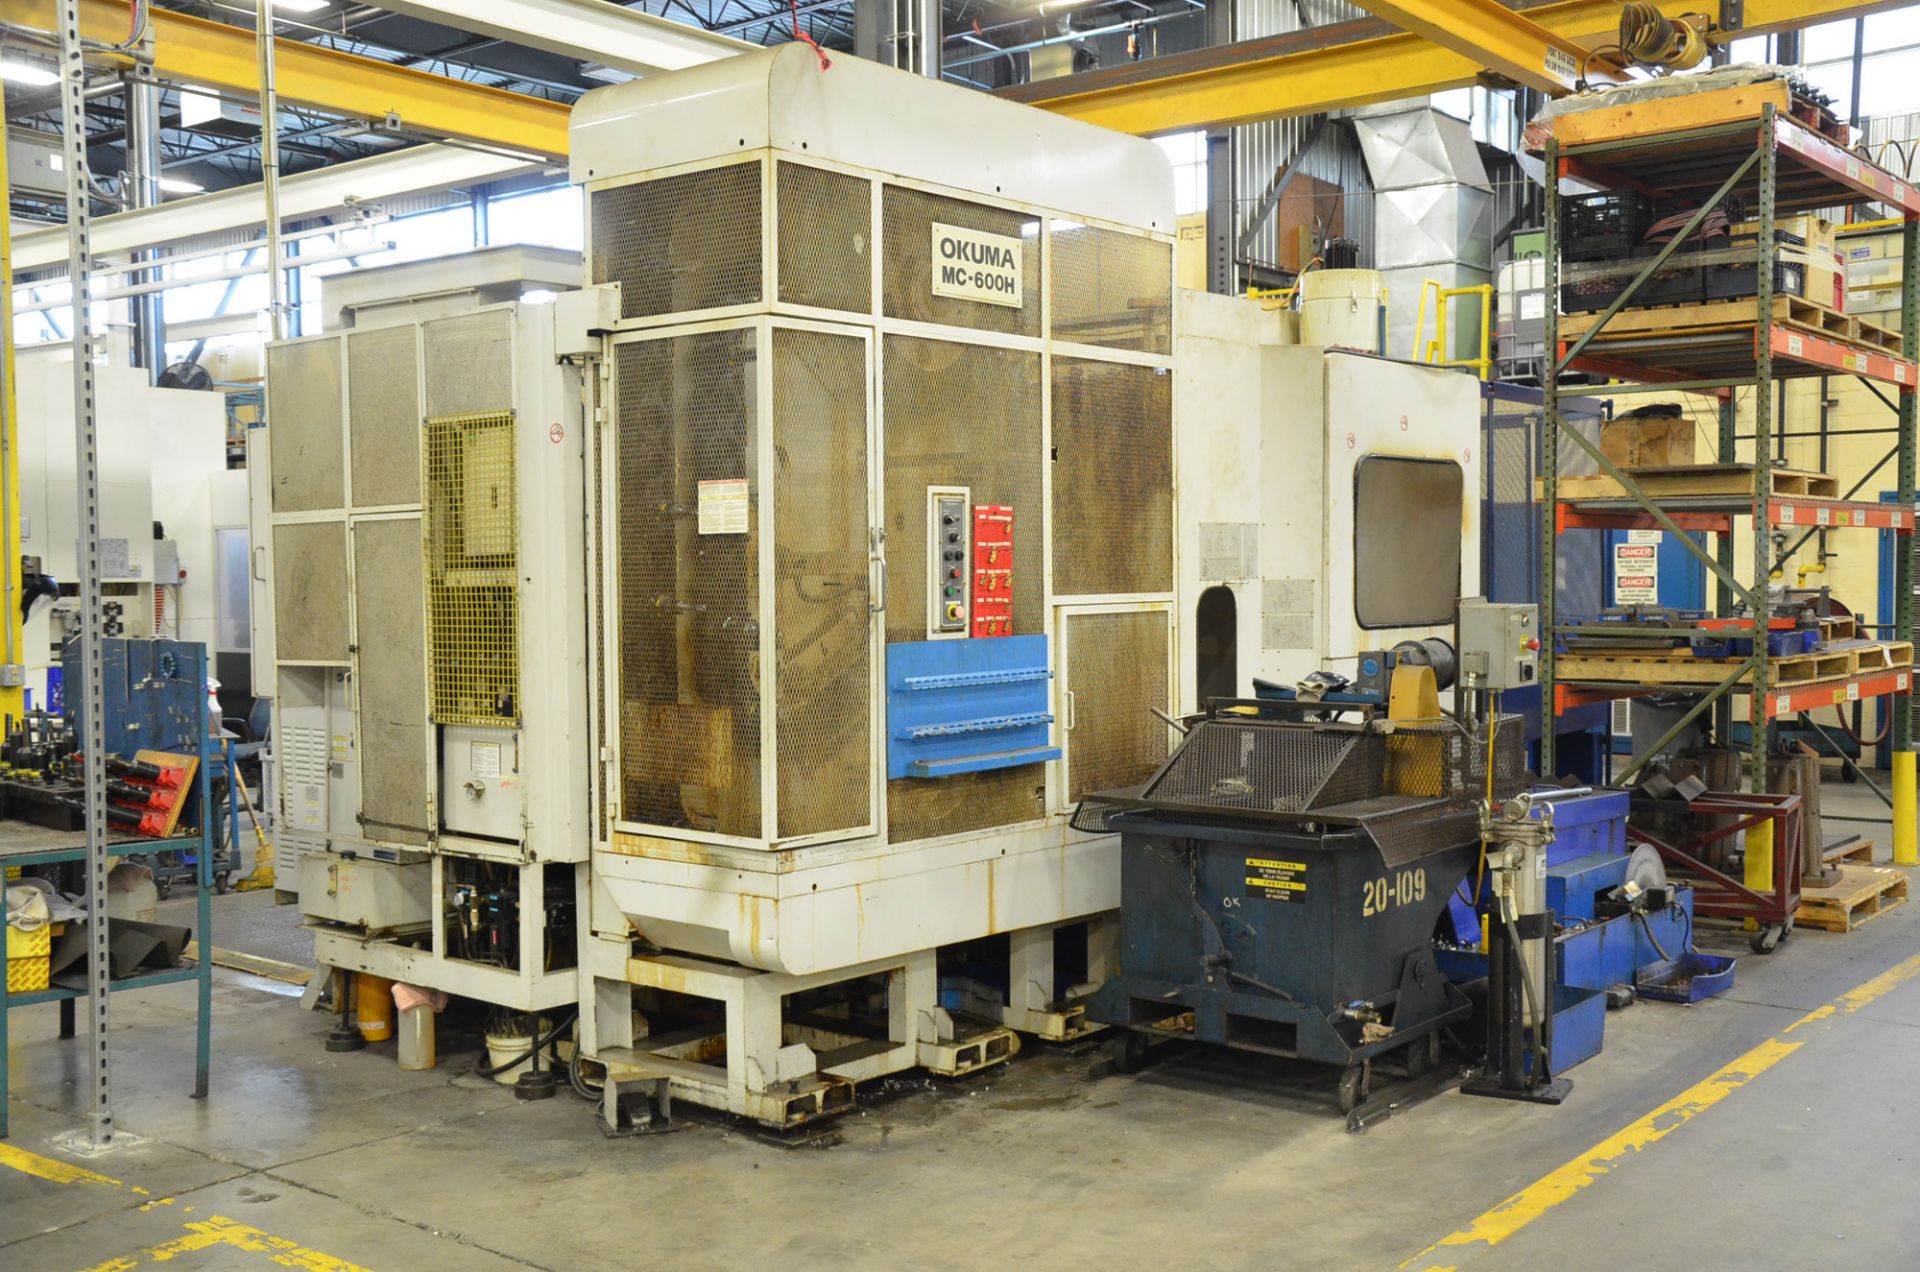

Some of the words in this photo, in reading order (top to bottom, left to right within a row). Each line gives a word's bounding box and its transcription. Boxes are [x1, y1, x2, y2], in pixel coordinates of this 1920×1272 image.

[940, 237, 1015, 270] OKUMA
[1620, 547, 1652, 556] DANGER
[1620, 577, 1652, 586] DANGER
[1260, 860, 1296, 869] ATTENTION
[1263, 880, 1292, 888] CAUTION
[1363, 867, 1426, 917] 20-109
[1223, 896, 1241, 908] OK
